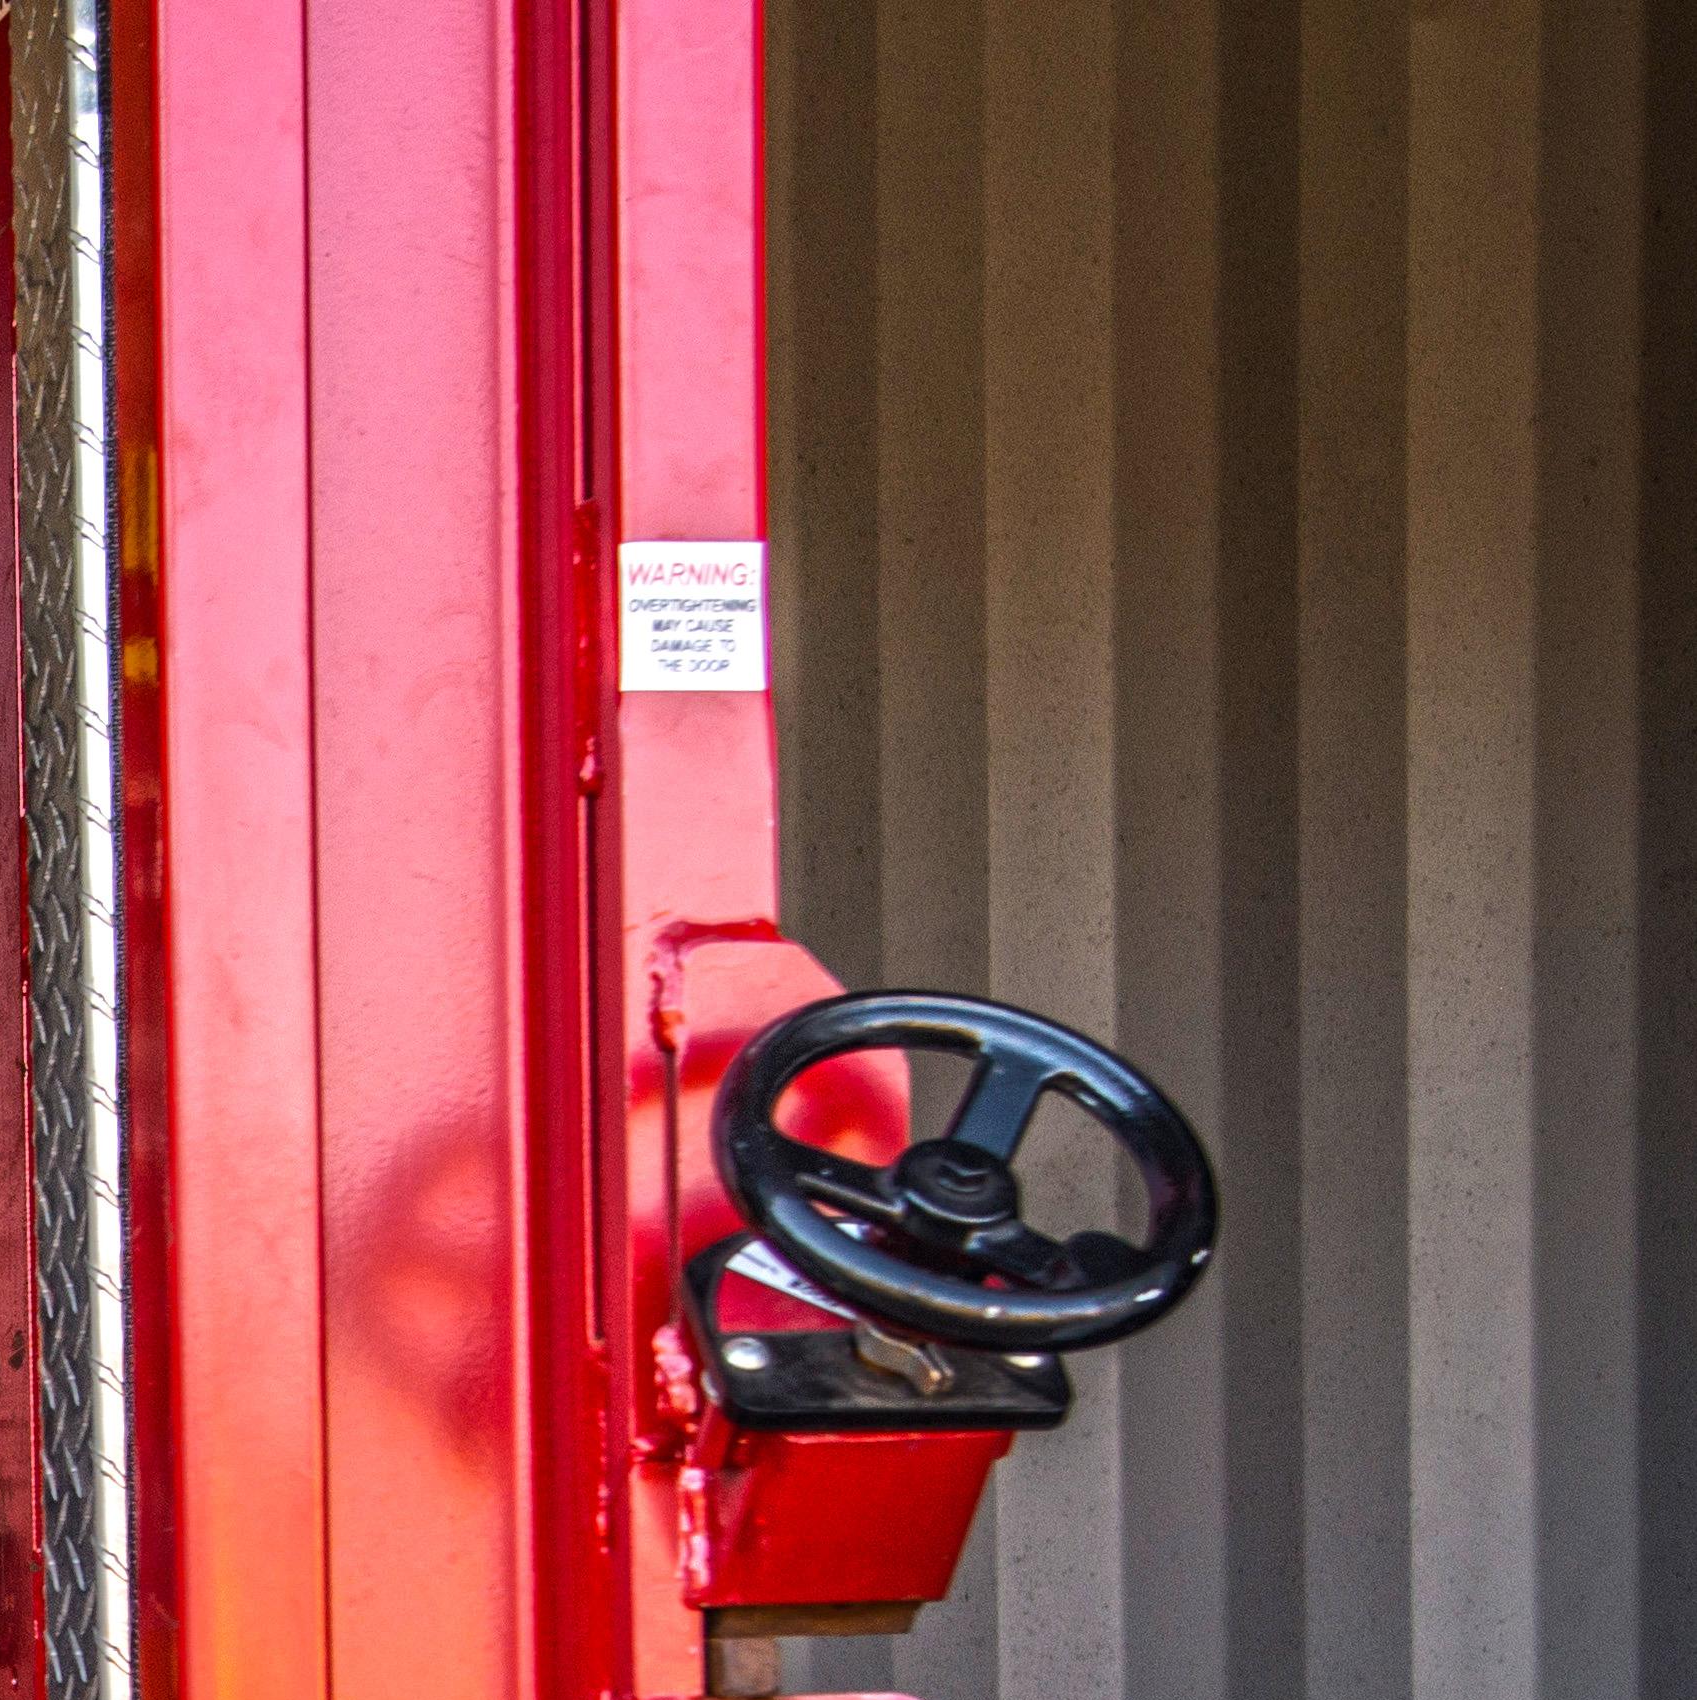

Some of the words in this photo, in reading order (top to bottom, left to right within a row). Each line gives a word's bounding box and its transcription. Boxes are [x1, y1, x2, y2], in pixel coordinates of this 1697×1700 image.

[628, 563, 756, 586] WARNING:
[652, 619, 681, 632] MAY
[686, 619, 735, 632] CAUSE
[651, 639, 712, 652] DAMAGE
[721, 639, 736, 652] TO
